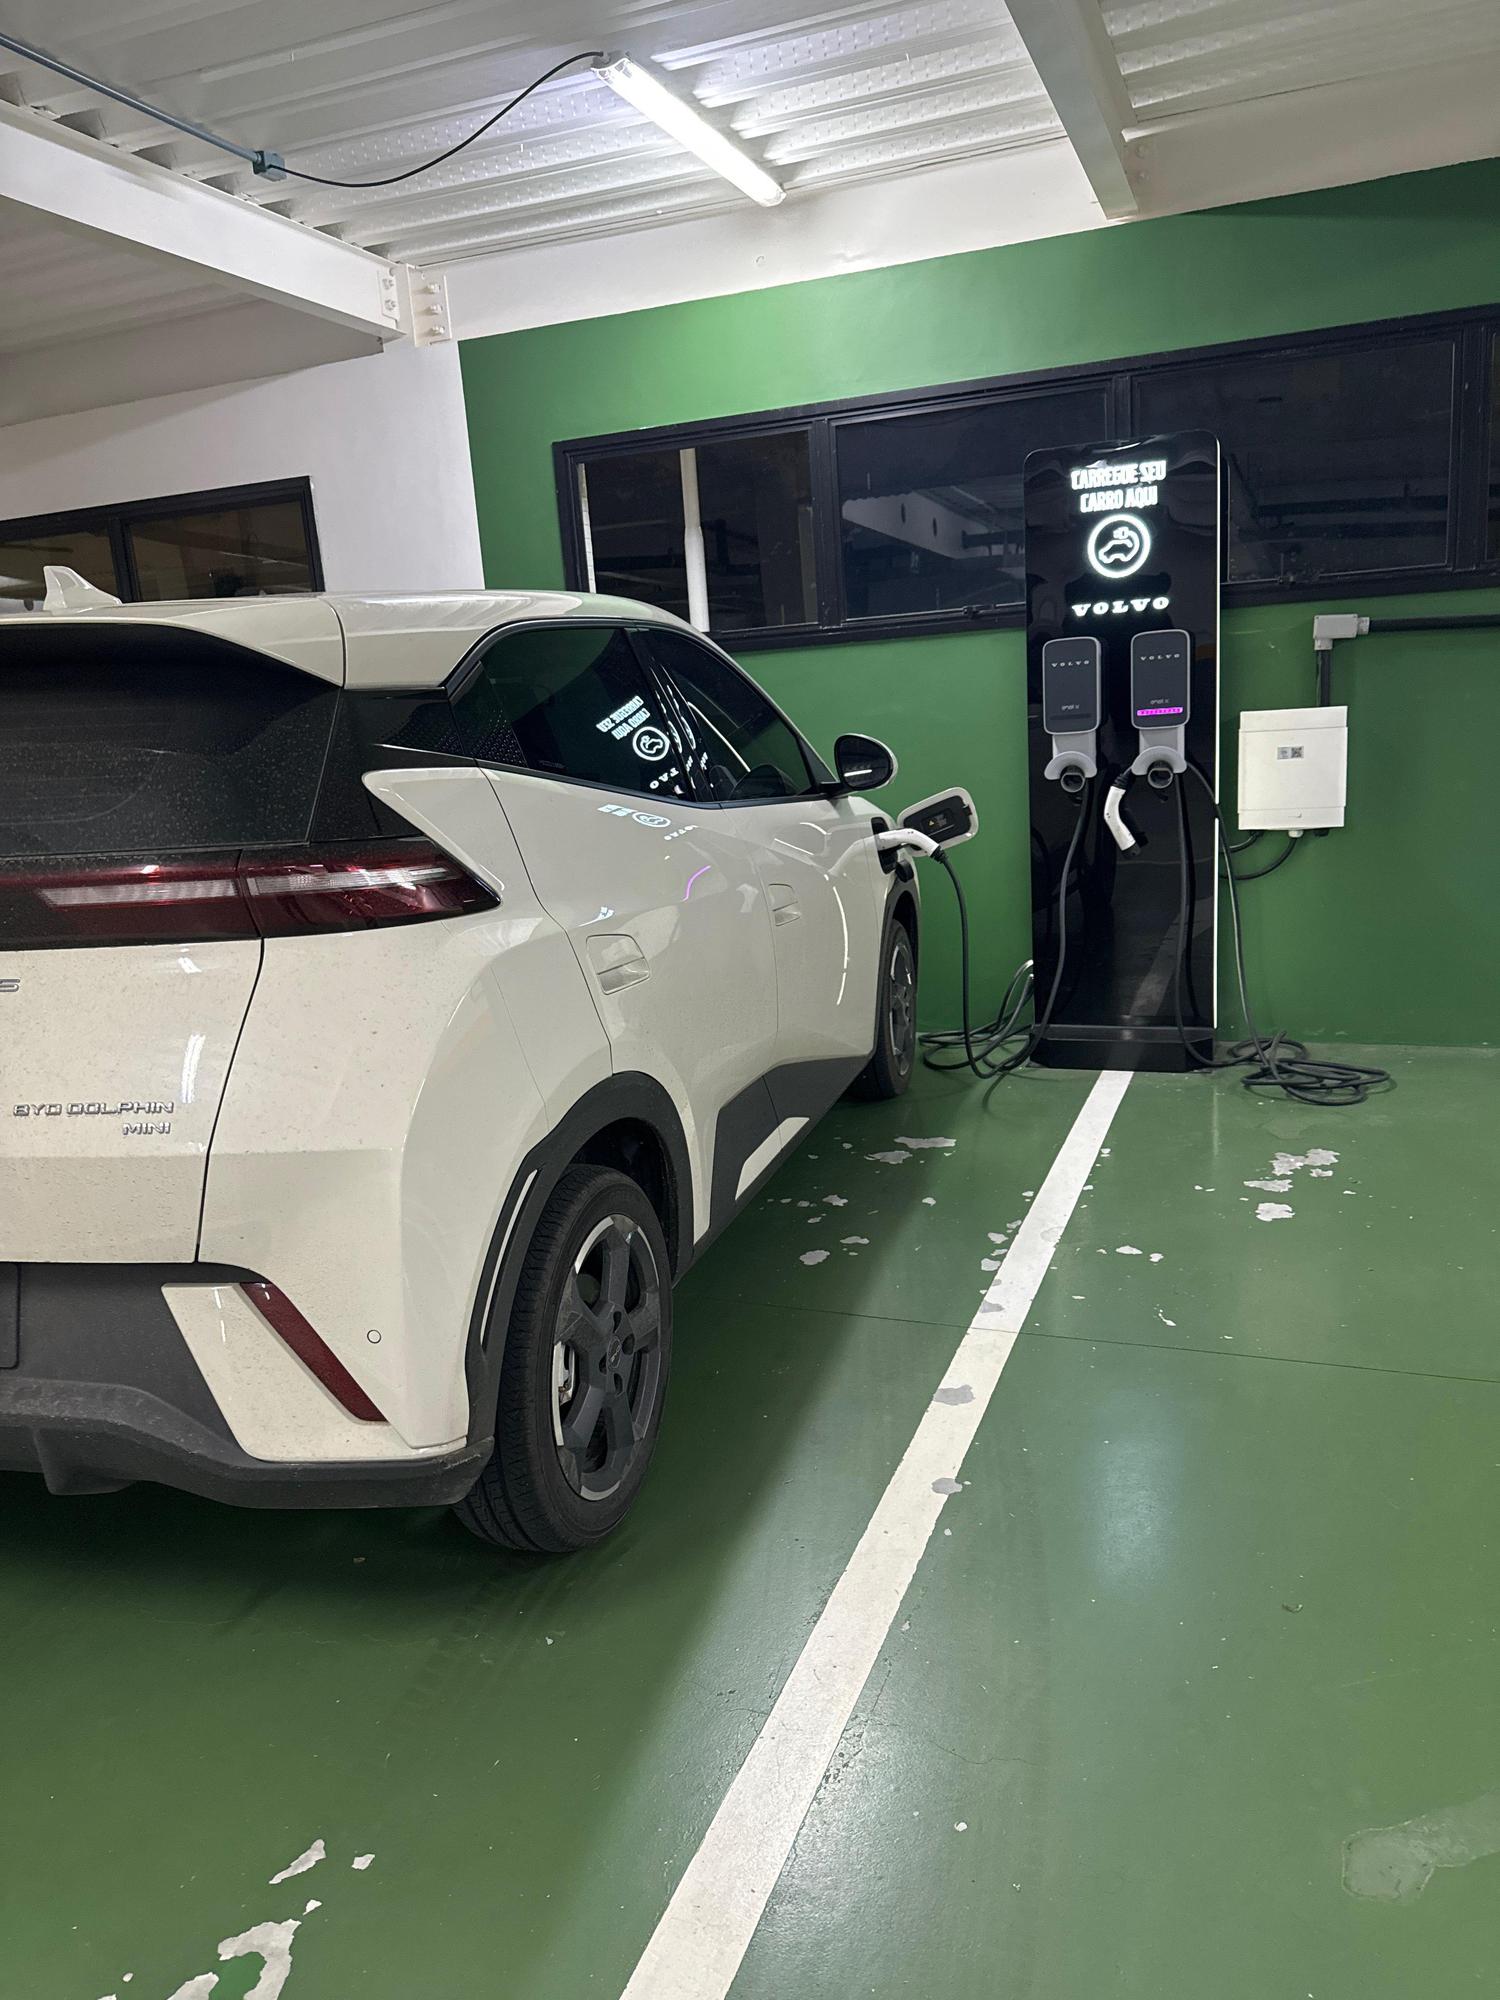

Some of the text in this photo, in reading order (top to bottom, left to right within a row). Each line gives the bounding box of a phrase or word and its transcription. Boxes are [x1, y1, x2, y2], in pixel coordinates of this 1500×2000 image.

[1070, 460, 1167, 490] CARREGUE SEU
[1080, 485, 1158, 513] CARRO AQUI
[1071, 596, 1170, 617] VOLVO
[1051, 660, 1090, 668] VOLVO
[1140, 653, 1180, 661] VOLVO
[13, 1101, 174, 1117] BYD DOLPHIN
[122, 1122, 171, 1135] MINI
